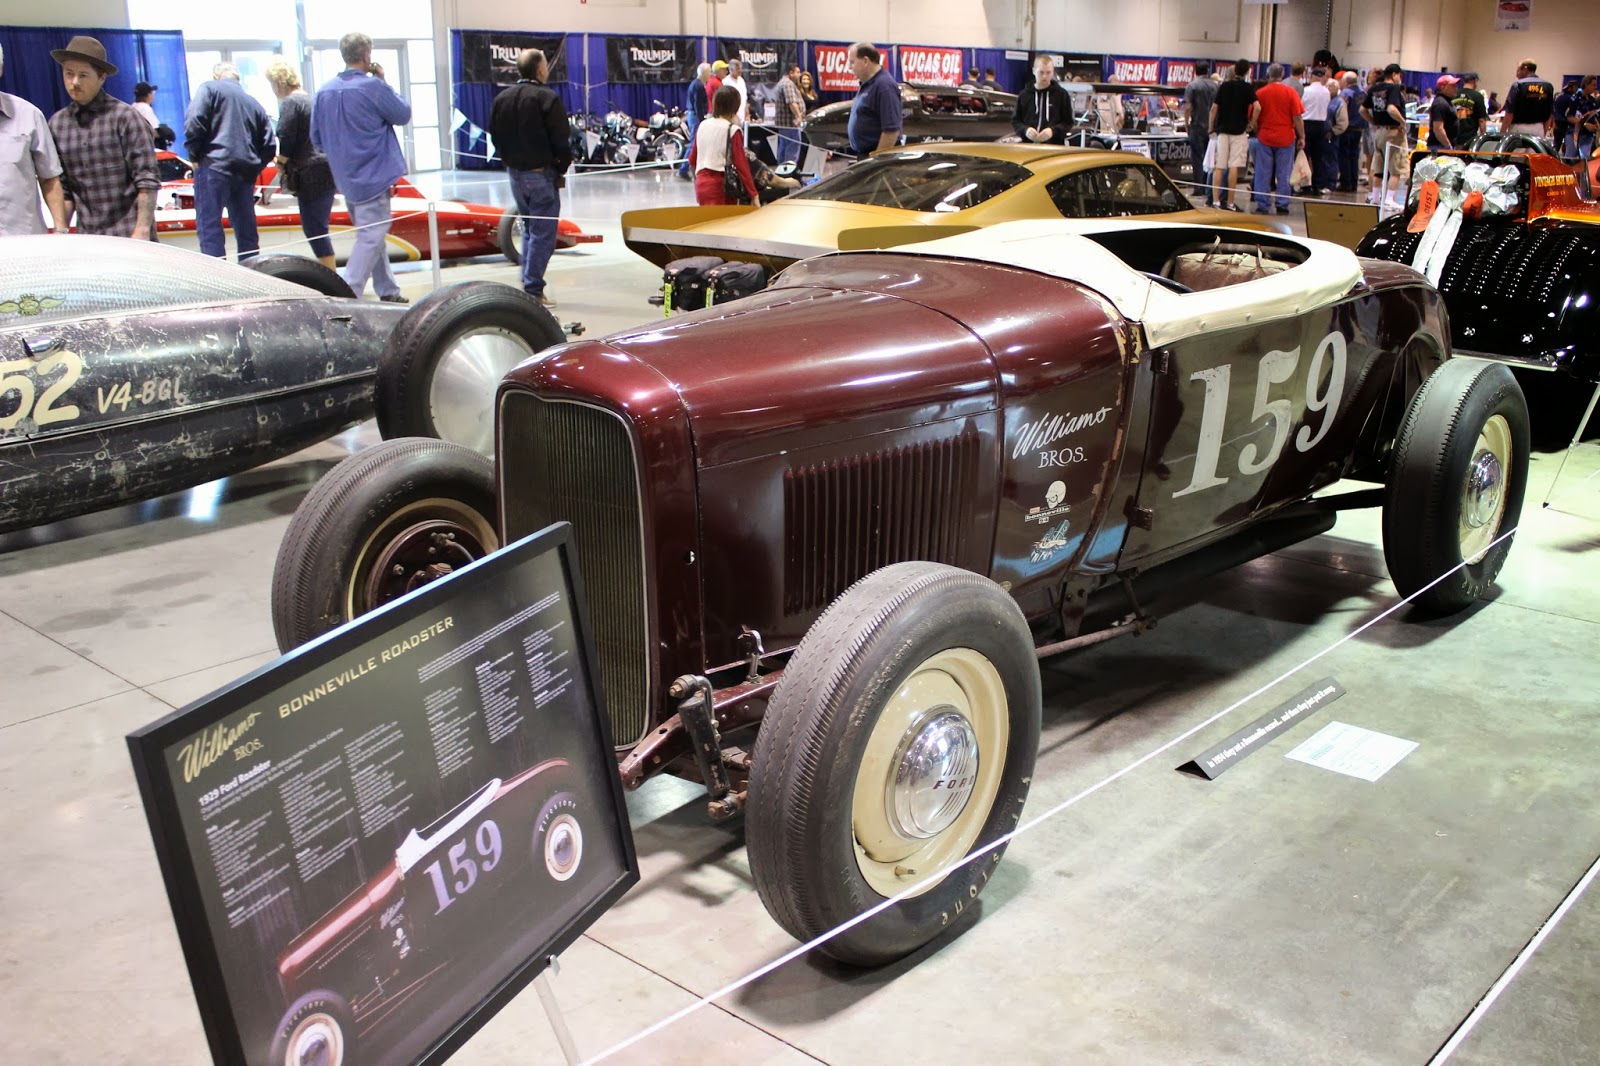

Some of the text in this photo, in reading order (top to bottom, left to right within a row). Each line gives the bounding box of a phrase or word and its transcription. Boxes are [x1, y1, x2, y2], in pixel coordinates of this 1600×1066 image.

[630, 46, 676, 64] TRIUMPH
[738, 49, 778, 66] TRIUMPH
[903, 51, 941, 74] LUCAS
[942, 53, 961, 74] OIL
[1115, 62, 1159, 82] LUCAS OIL
[1167, 65, 1195, 83] LUCAS
[1424, 192, 1433, 214] DEIST
[1172, 331, 1347, 498] 159
[1012, 406, 1112, 459] Williams
[1038, 446, 1088, 469] BROS.
[278, 657, 377, 719] BONNEVILLE
[381, 616, 455, 663] ROADSTER
[177, 711, 262, 783] Williams
[234, 738, 264, 761] BROS.
[199, 760, 271, 806] 1929 Ford Roadster
[932, 775, 975, 790] FORD
[423, 820, 503, 916] 159
